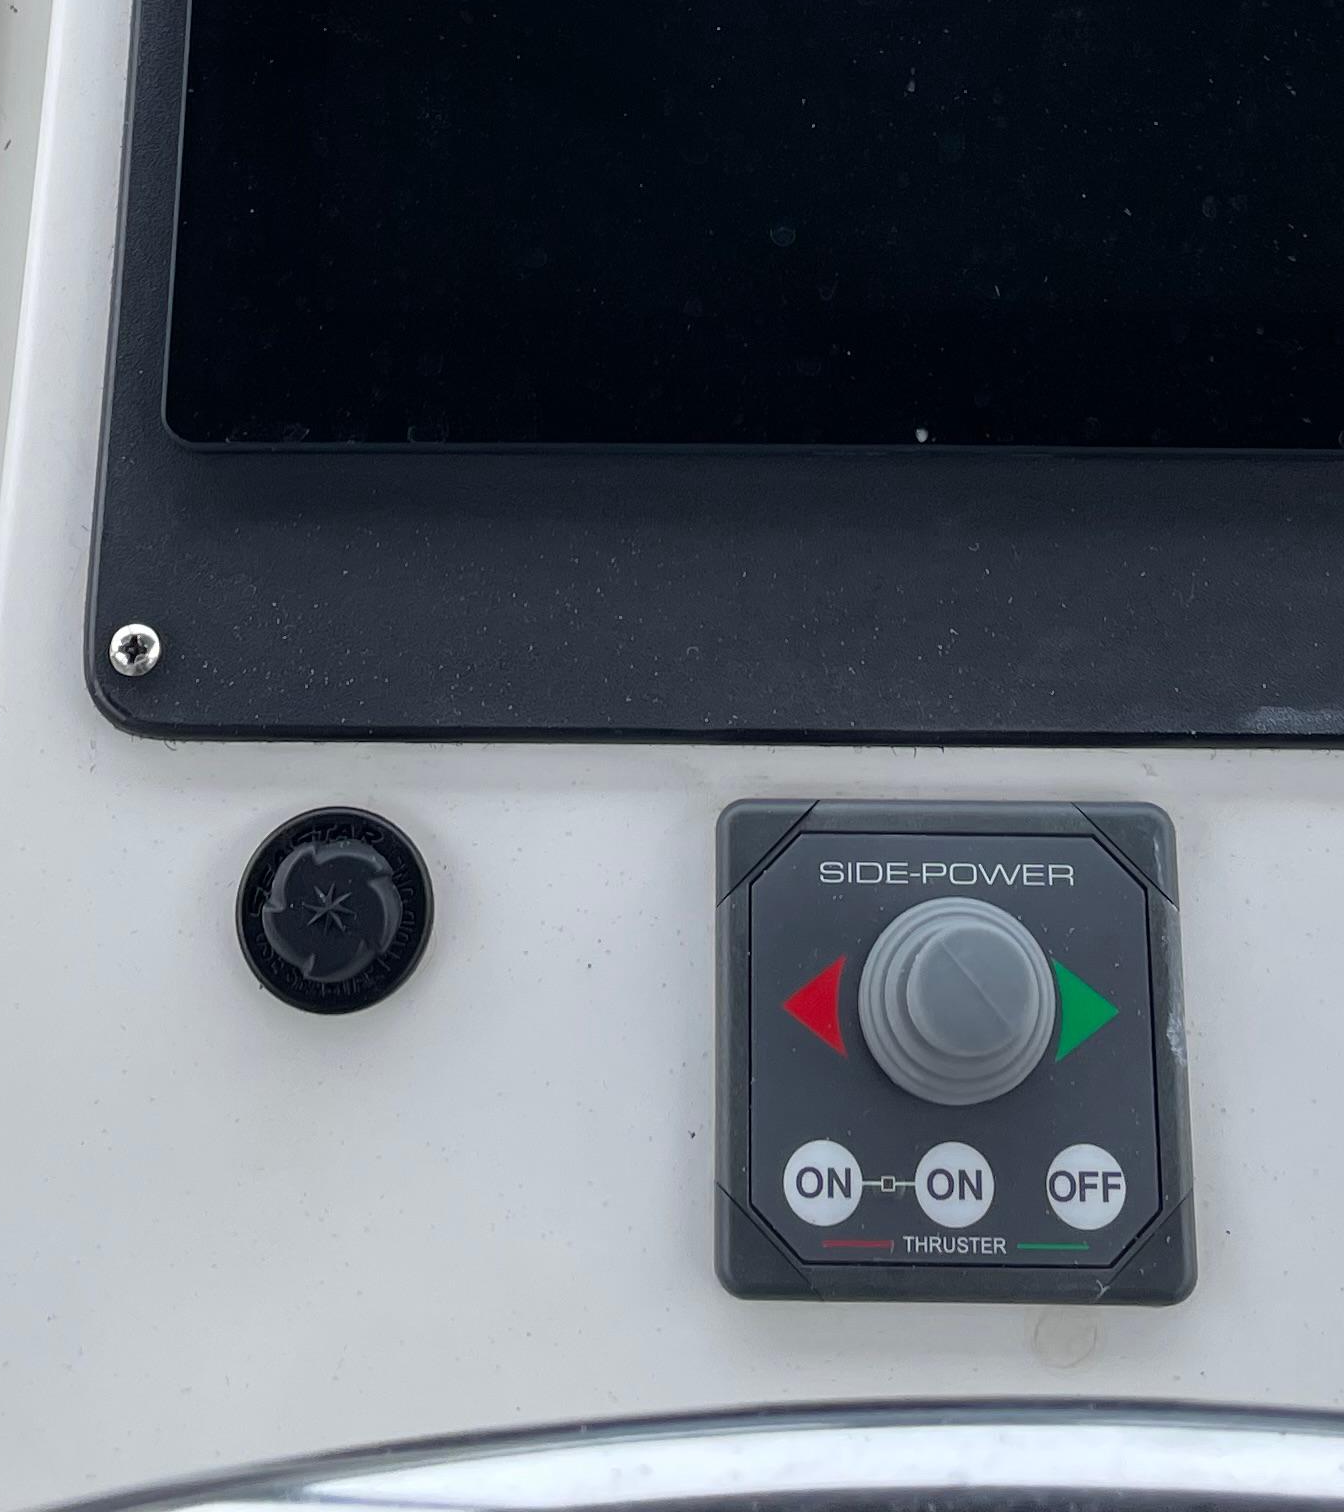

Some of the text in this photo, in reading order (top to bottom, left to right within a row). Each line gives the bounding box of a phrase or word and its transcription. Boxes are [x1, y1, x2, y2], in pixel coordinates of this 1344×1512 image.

[819, 860, 1075, 887] SIDE-POWER
[795, 1167, 853, 1200] ON
[926, 1168, 984, 1202] ON
[1048, 1170, 1123, 1204] OFF
[902, 1235, 1008, 1256] THRUSTER
